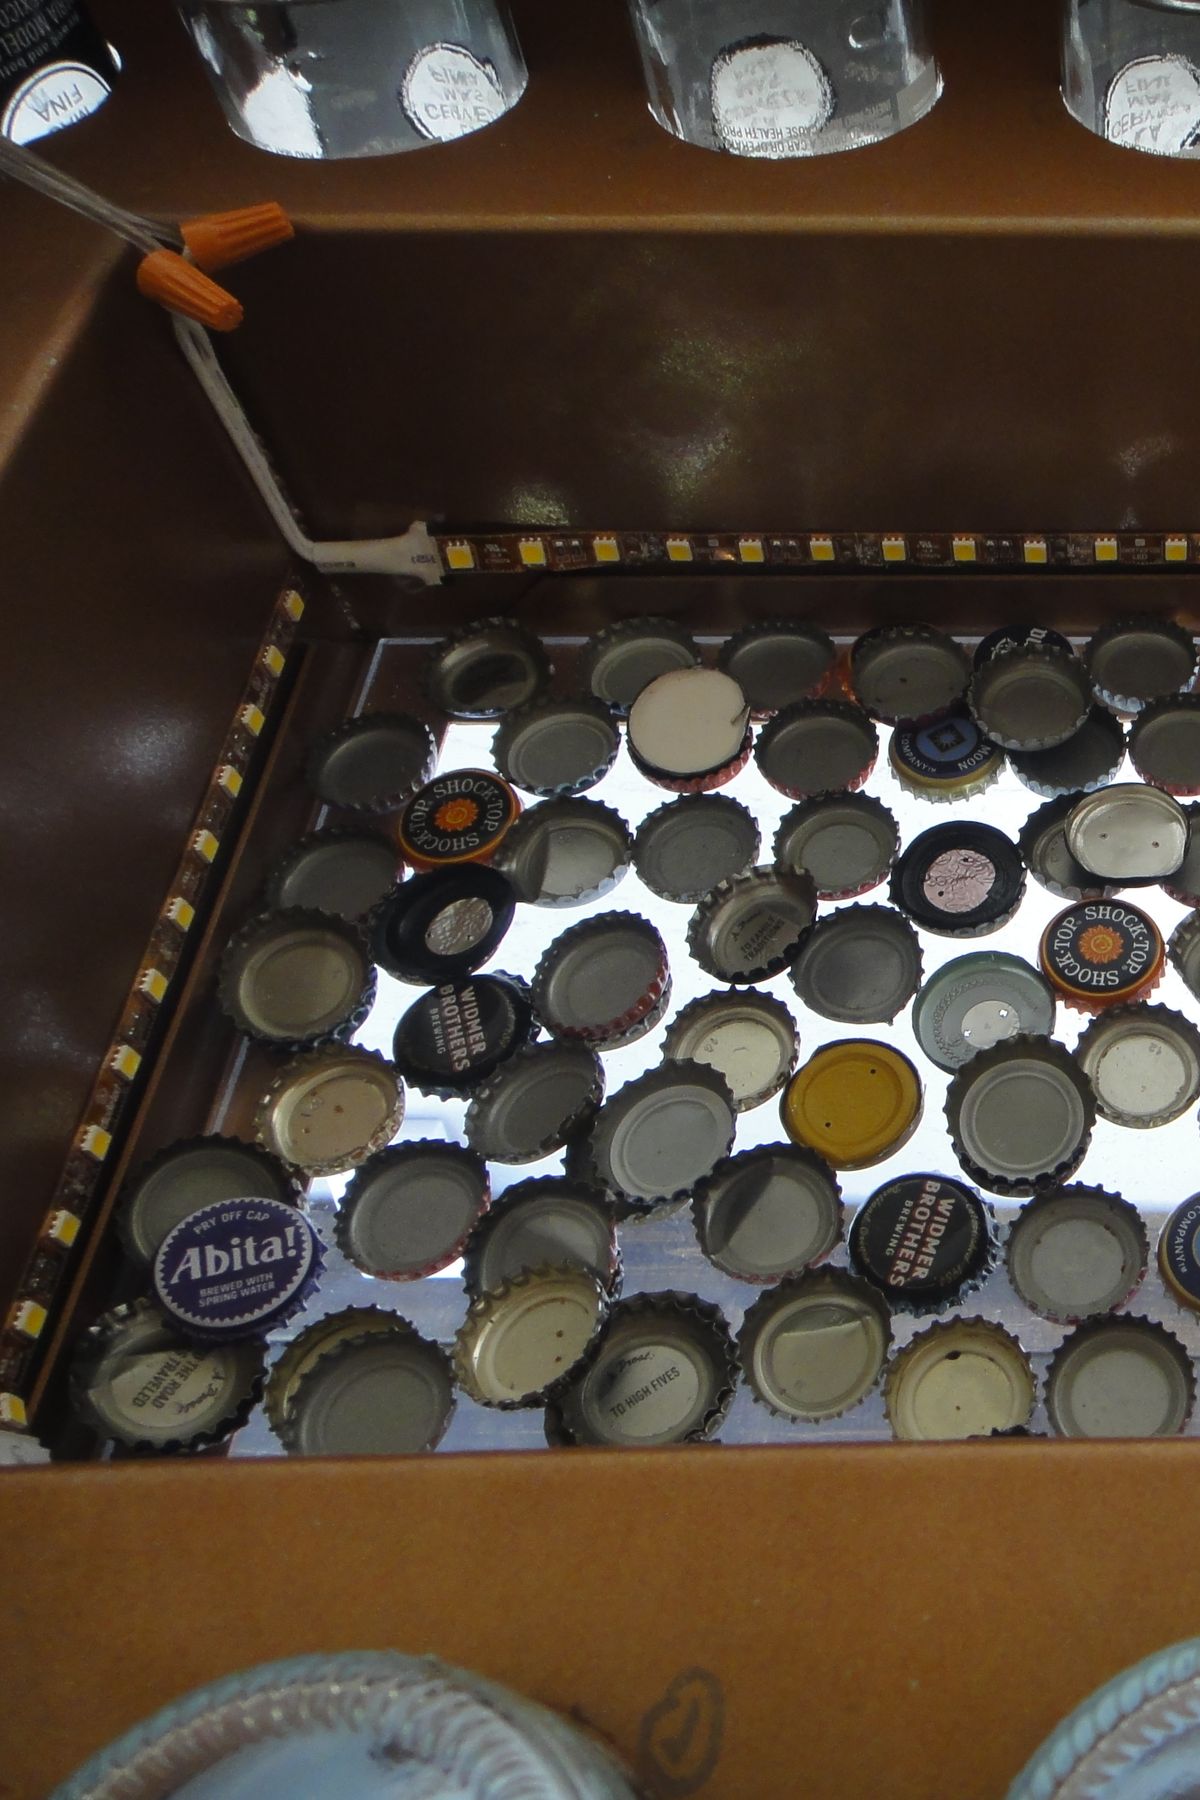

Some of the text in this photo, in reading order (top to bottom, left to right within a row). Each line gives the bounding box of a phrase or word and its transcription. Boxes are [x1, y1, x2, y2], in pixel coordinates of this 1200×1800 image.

[31, 82, 84, 123] FINA
[744, 127, 783, 140] HEALTH
[958, 744, 993, 772] MOON
[430, 1007, 447, 1056] BREWING
[438, 983, 471, 1073] BROTHERS
[459, 984, 487, 1057] WIDMER
[194, 1208, 272, 1236] PRY OFF CAP
[885, 1198, 913, 1258] BREWING
[890, 1179, 940, 1288] BROTHERS
[915, 1196, 956, 1281] WIDMER
[169, 1226, 299, 1285] Abita!
[198, 1280, 276, 1308] SPRING WATER
[199, 1271, 275, 1299] BREWED WITH
[131, 1357, 183, 1408] TRAVELED
[151, 1360, 200, 1409] THE ROAD
[609, 1364, 682, 1421] TO HIGH FIVES
